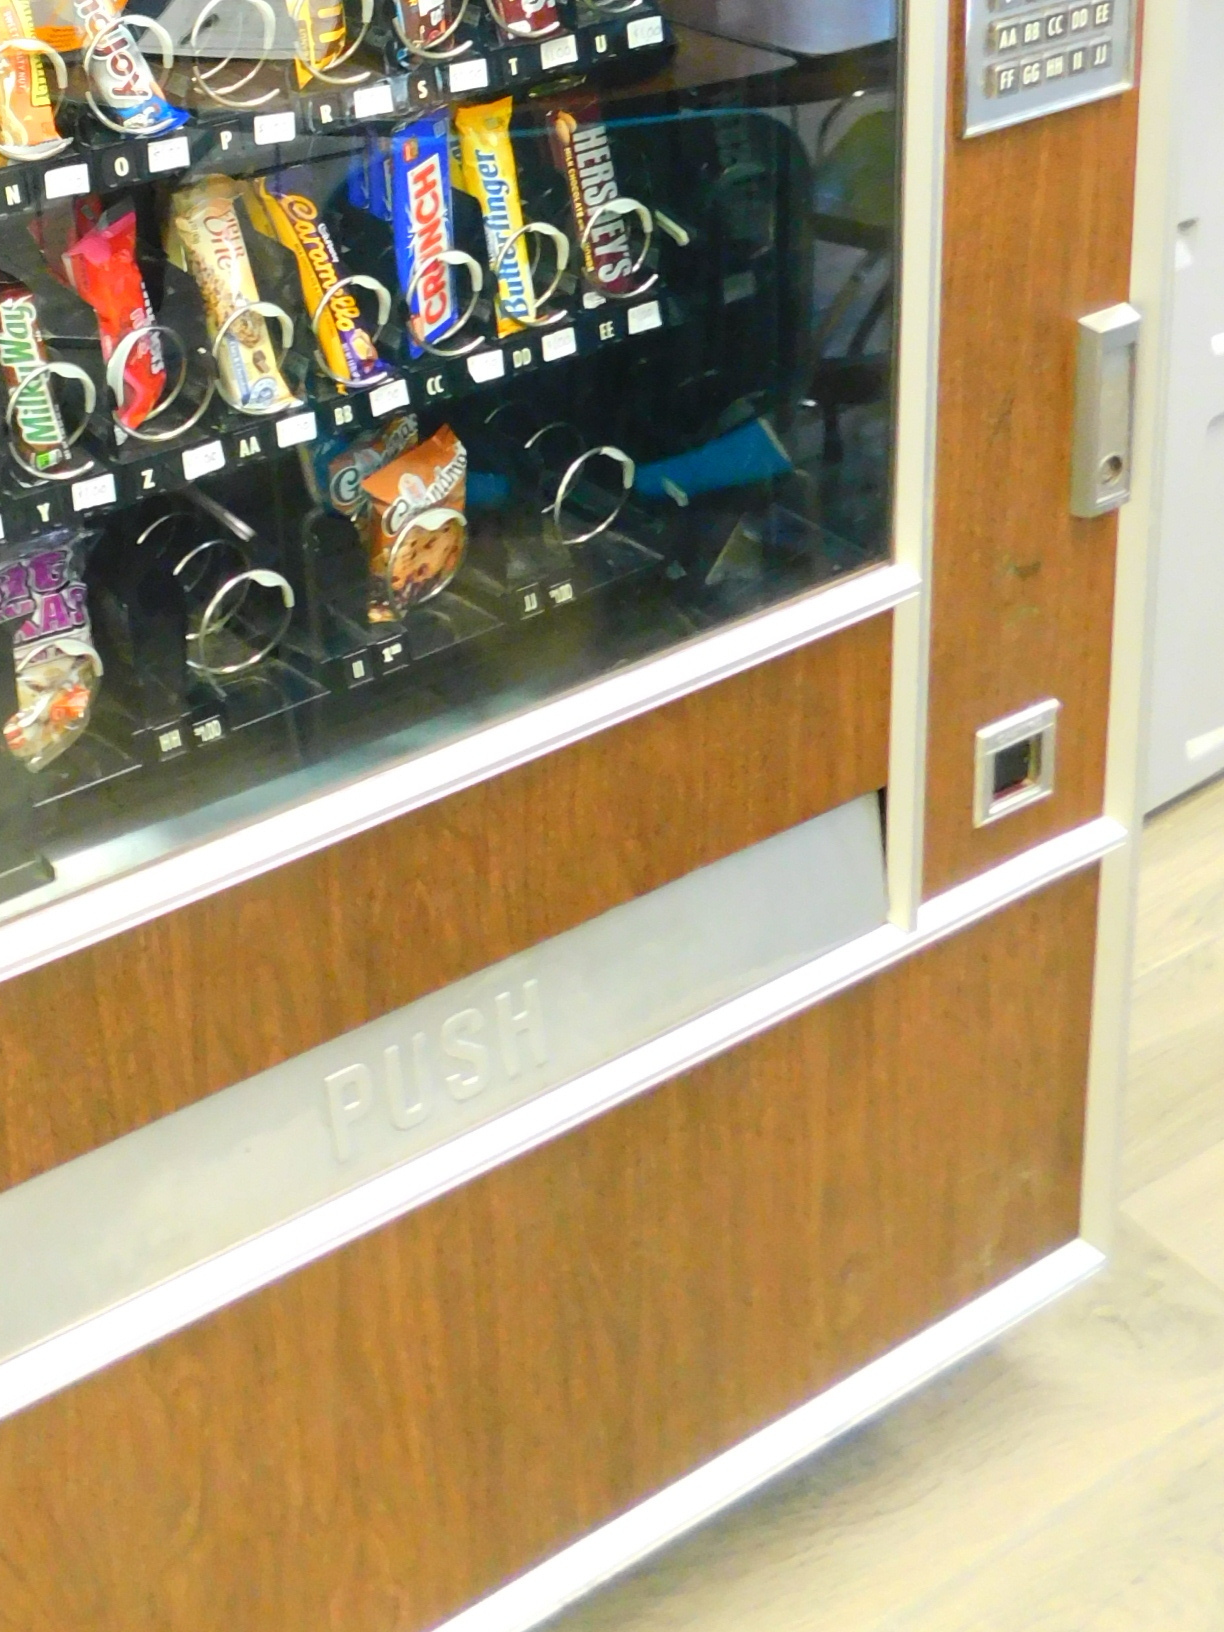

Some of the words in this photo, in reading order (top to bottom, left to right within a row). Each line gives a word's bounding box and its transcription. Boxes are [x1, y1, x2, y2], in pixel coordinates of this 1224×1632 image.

[999, 28, 1017, 49] AA
[1025, 21, 1040, 43] BB
[1047, 15, 1064, 36] CC
[1071, 8, 1089, 30] DD
[1096, 3, 1110, 25] EE
[595, 34, 607, 54] U
[92, 24, 153, 101] Joy
[507, 57, 518, 76] T
[1000, 69, 1015, 90] FF
[1022, 62, 1041, 85] GG
[1046, 55, 1064, 78] HH
[1094, 44, 1107, 65] JJ
[417, 79, 428, 100] S
[319, 104, 334, 125] R
[219, 130, 232, 151] P
[4, 184, 22, 207] N
[572, 124, 634, 284] HERSHEY'S
[411, 162, 448, 326] CRUNCH
[475, 148, 529, 319] Butterfinger
[426, 374, 444, 396] CC
[334, 404, 353, 426] BB
[239, 435, 261, 458] AA
[140, 468, 155, 490] Z
[36, 502, 50, 523] Y
[322, 977, 550, 1164] PUSH
